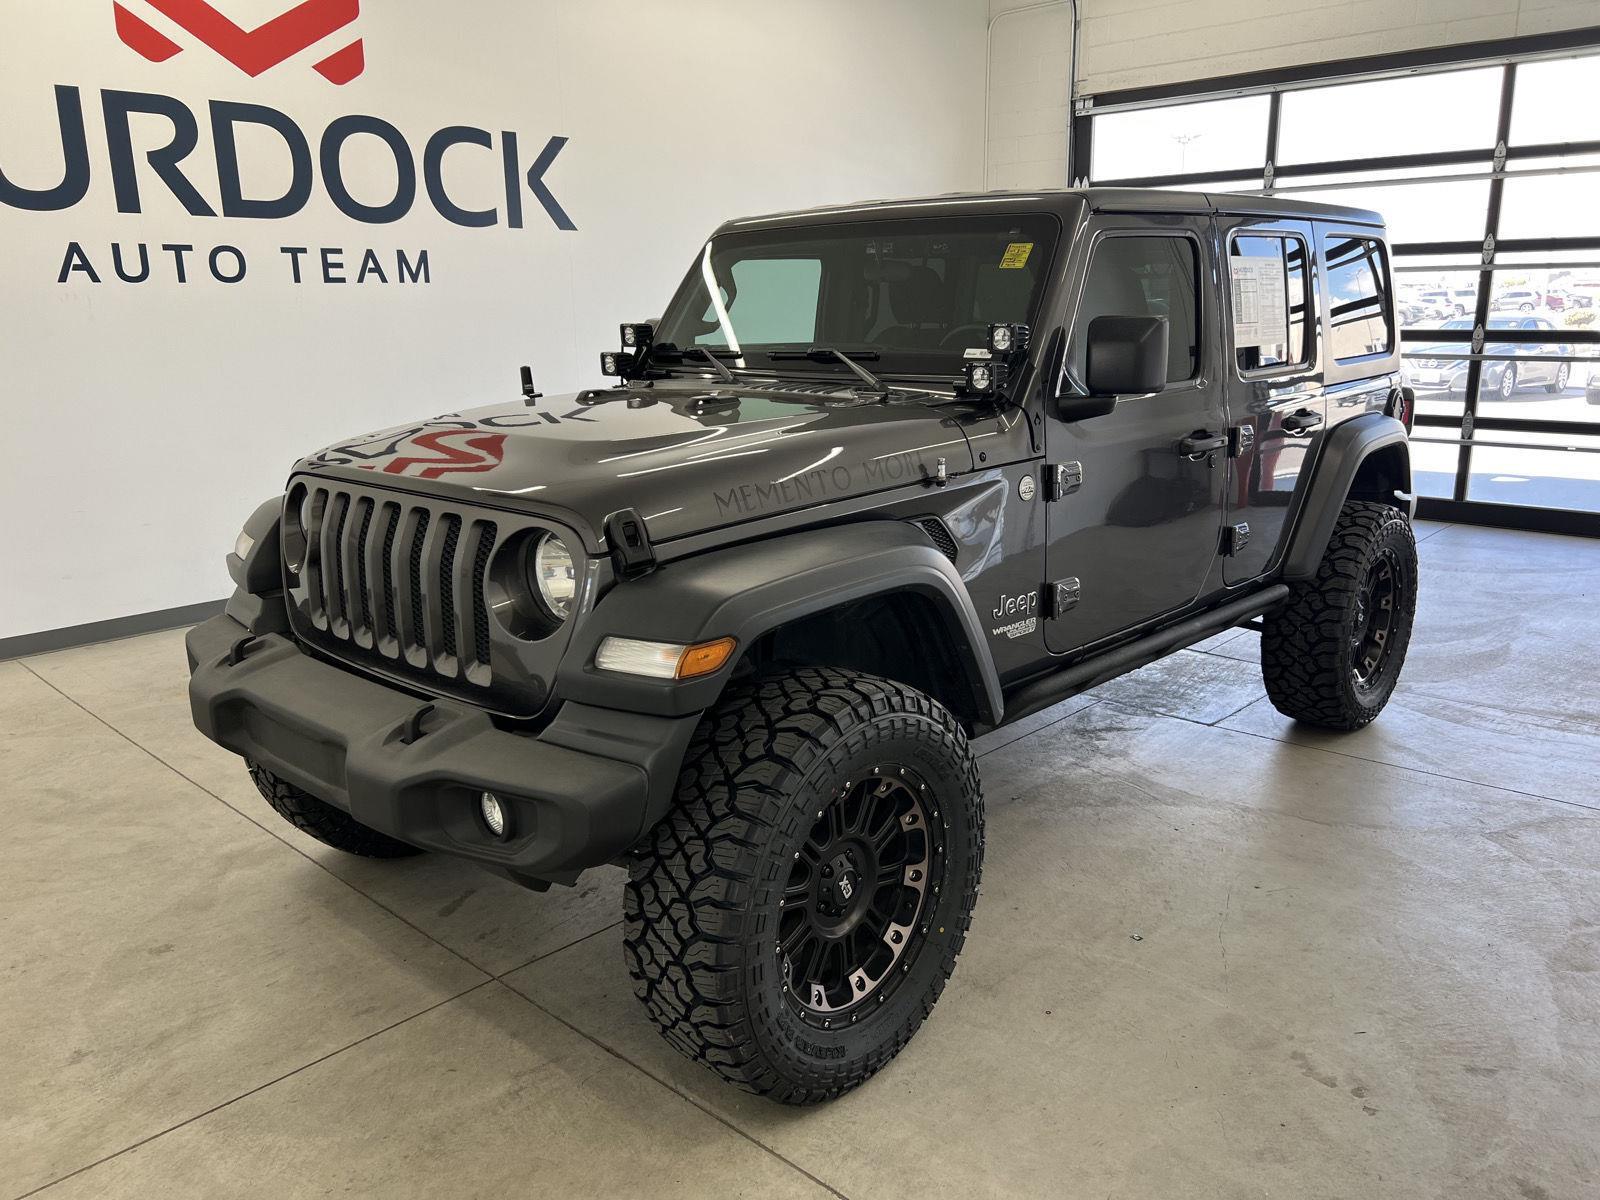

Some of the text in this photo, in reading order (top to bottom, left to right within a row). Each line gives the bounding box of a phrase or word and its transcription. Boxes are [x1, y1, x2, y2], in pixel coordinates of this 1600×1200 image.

[57, 242, 431, 284] AUTO TEAM
[713, 466, 851, 518] MEMENTO
[992, 591, 1037, 620] Jeep
[992, 617, 1037, 636] WRANGLER
